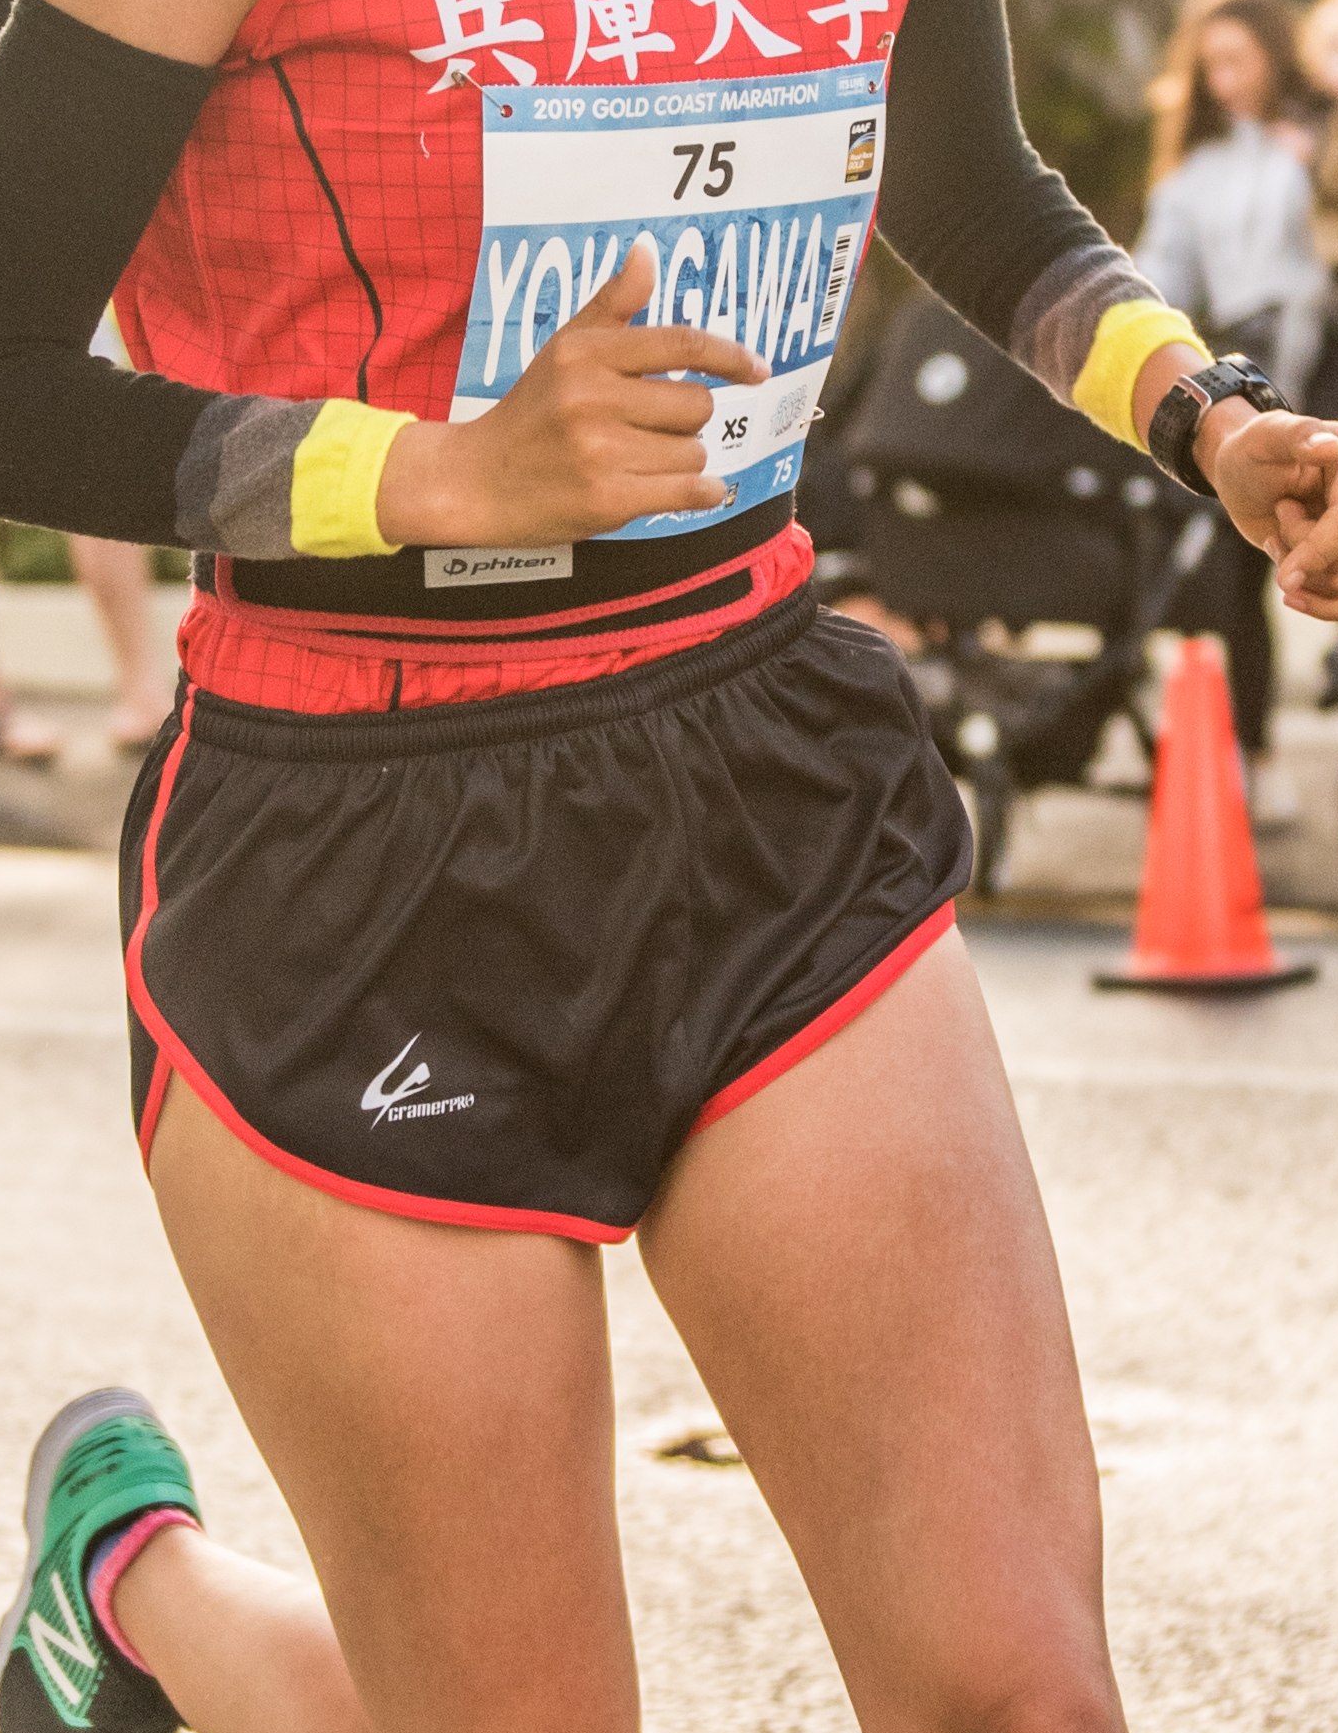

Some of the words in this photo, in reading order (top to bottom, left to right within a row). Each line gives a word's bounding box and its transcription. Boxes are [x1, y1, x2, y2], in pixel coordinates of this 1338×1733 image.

[533, 98, 586, 120] 2019
[592, 96, 649, 119] GOLD
[654, 92, 717, 116] COAST
[720, 82, 819, 112] MARATHON
[851, 122, 872, 135] IAAF
[672, 140, 736, 201] 75
[721, 416, 749, 442] XS
[772, 454, 795, 488] 75
[470, 556, 556, 576] phiten
